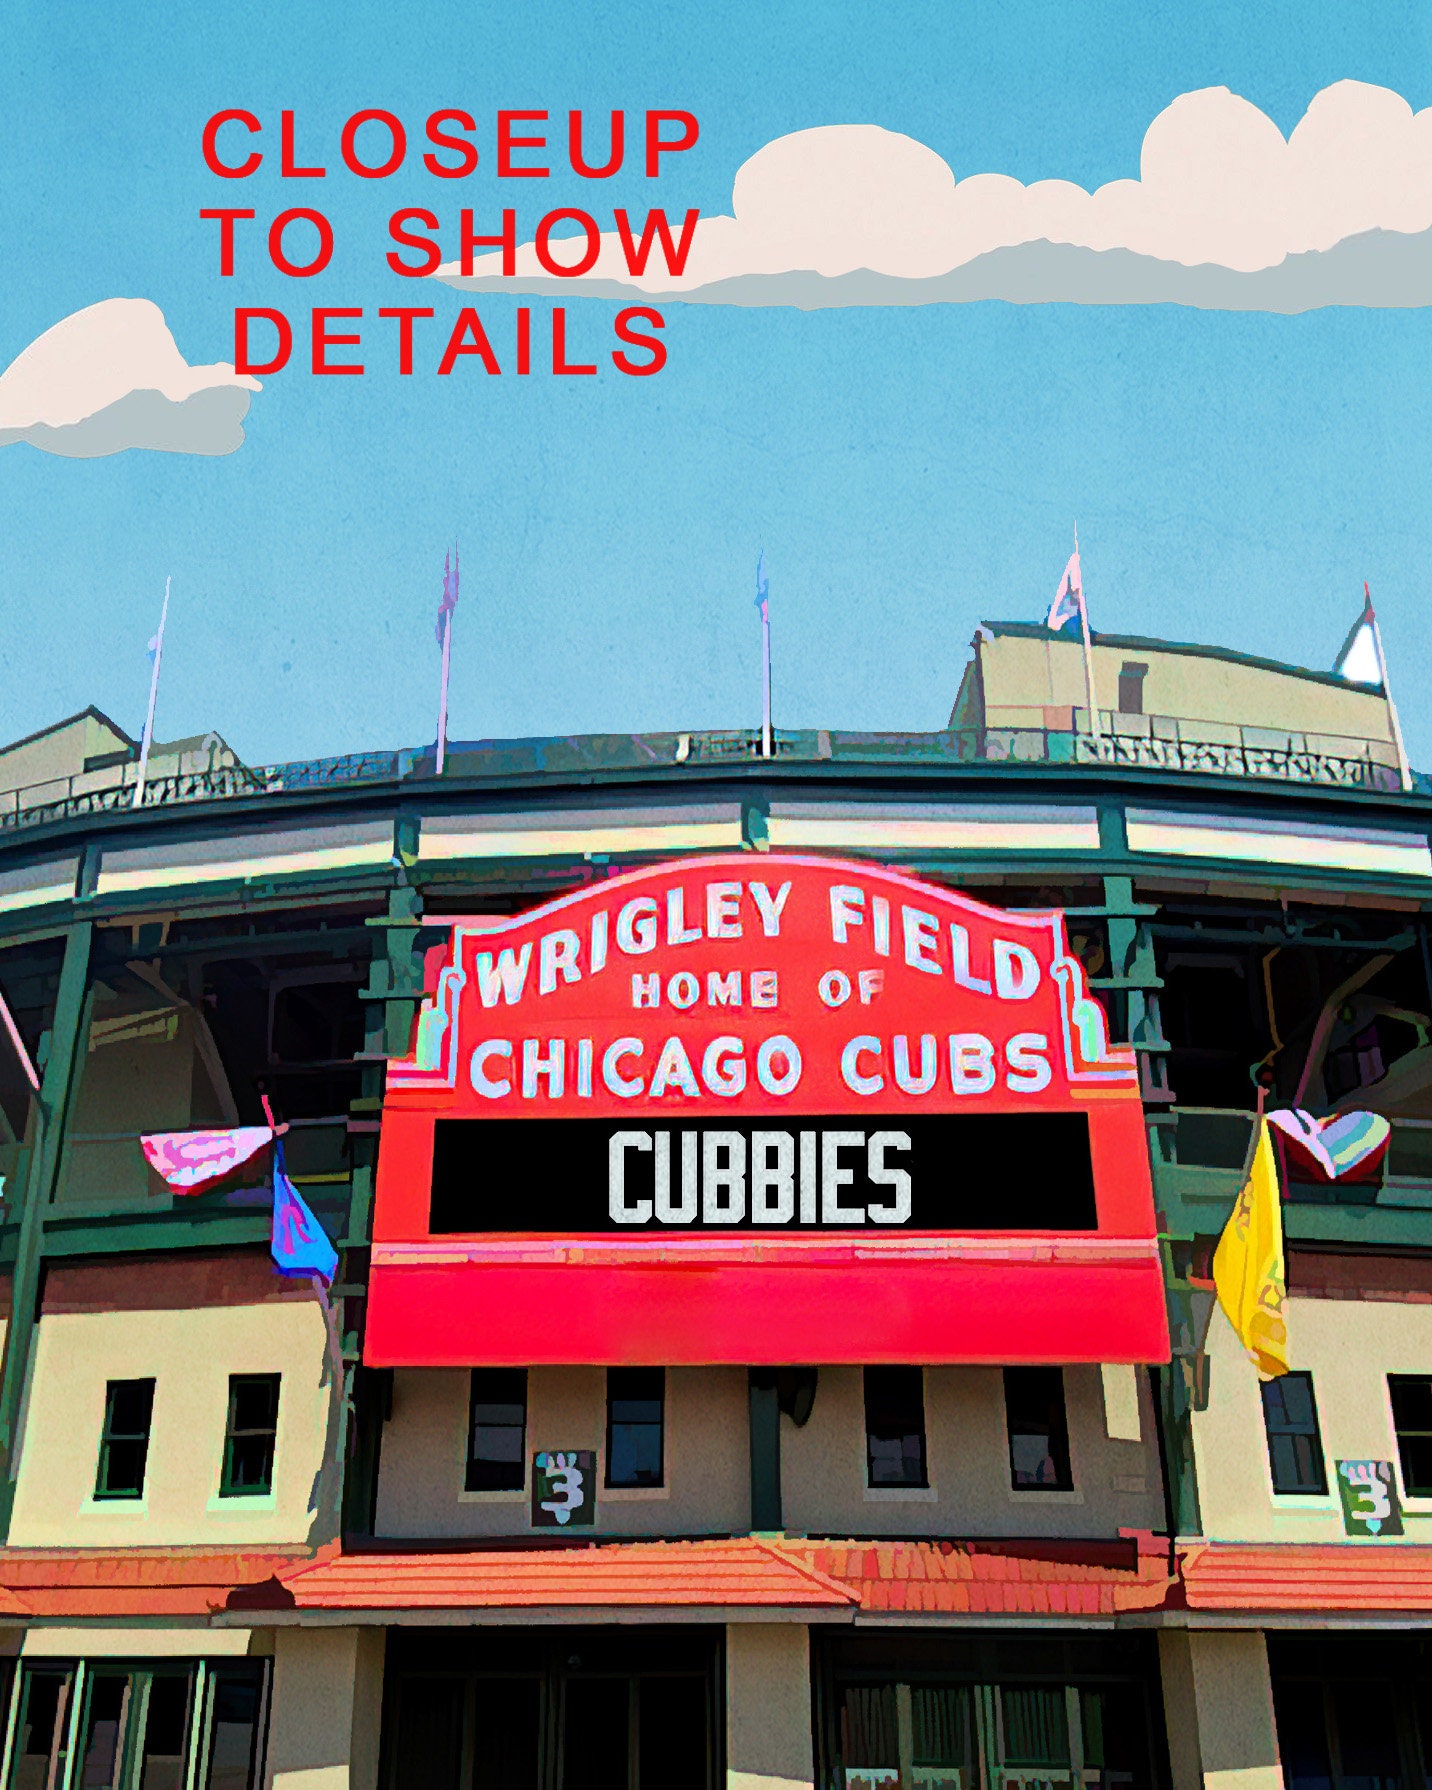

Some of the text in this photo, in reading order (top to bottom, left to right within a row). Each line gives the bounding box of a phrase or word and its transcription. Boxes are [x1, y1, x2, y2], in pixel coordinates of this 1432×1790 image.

[475, 880, 1042, 1009] WRIGLEY FIELD
[631, 968, 885, 1010] HOME OF
[470, 1032, 1052, 1099] CHICAGO CUBS
[608, 1130, 912, 1224] CUBBIES
